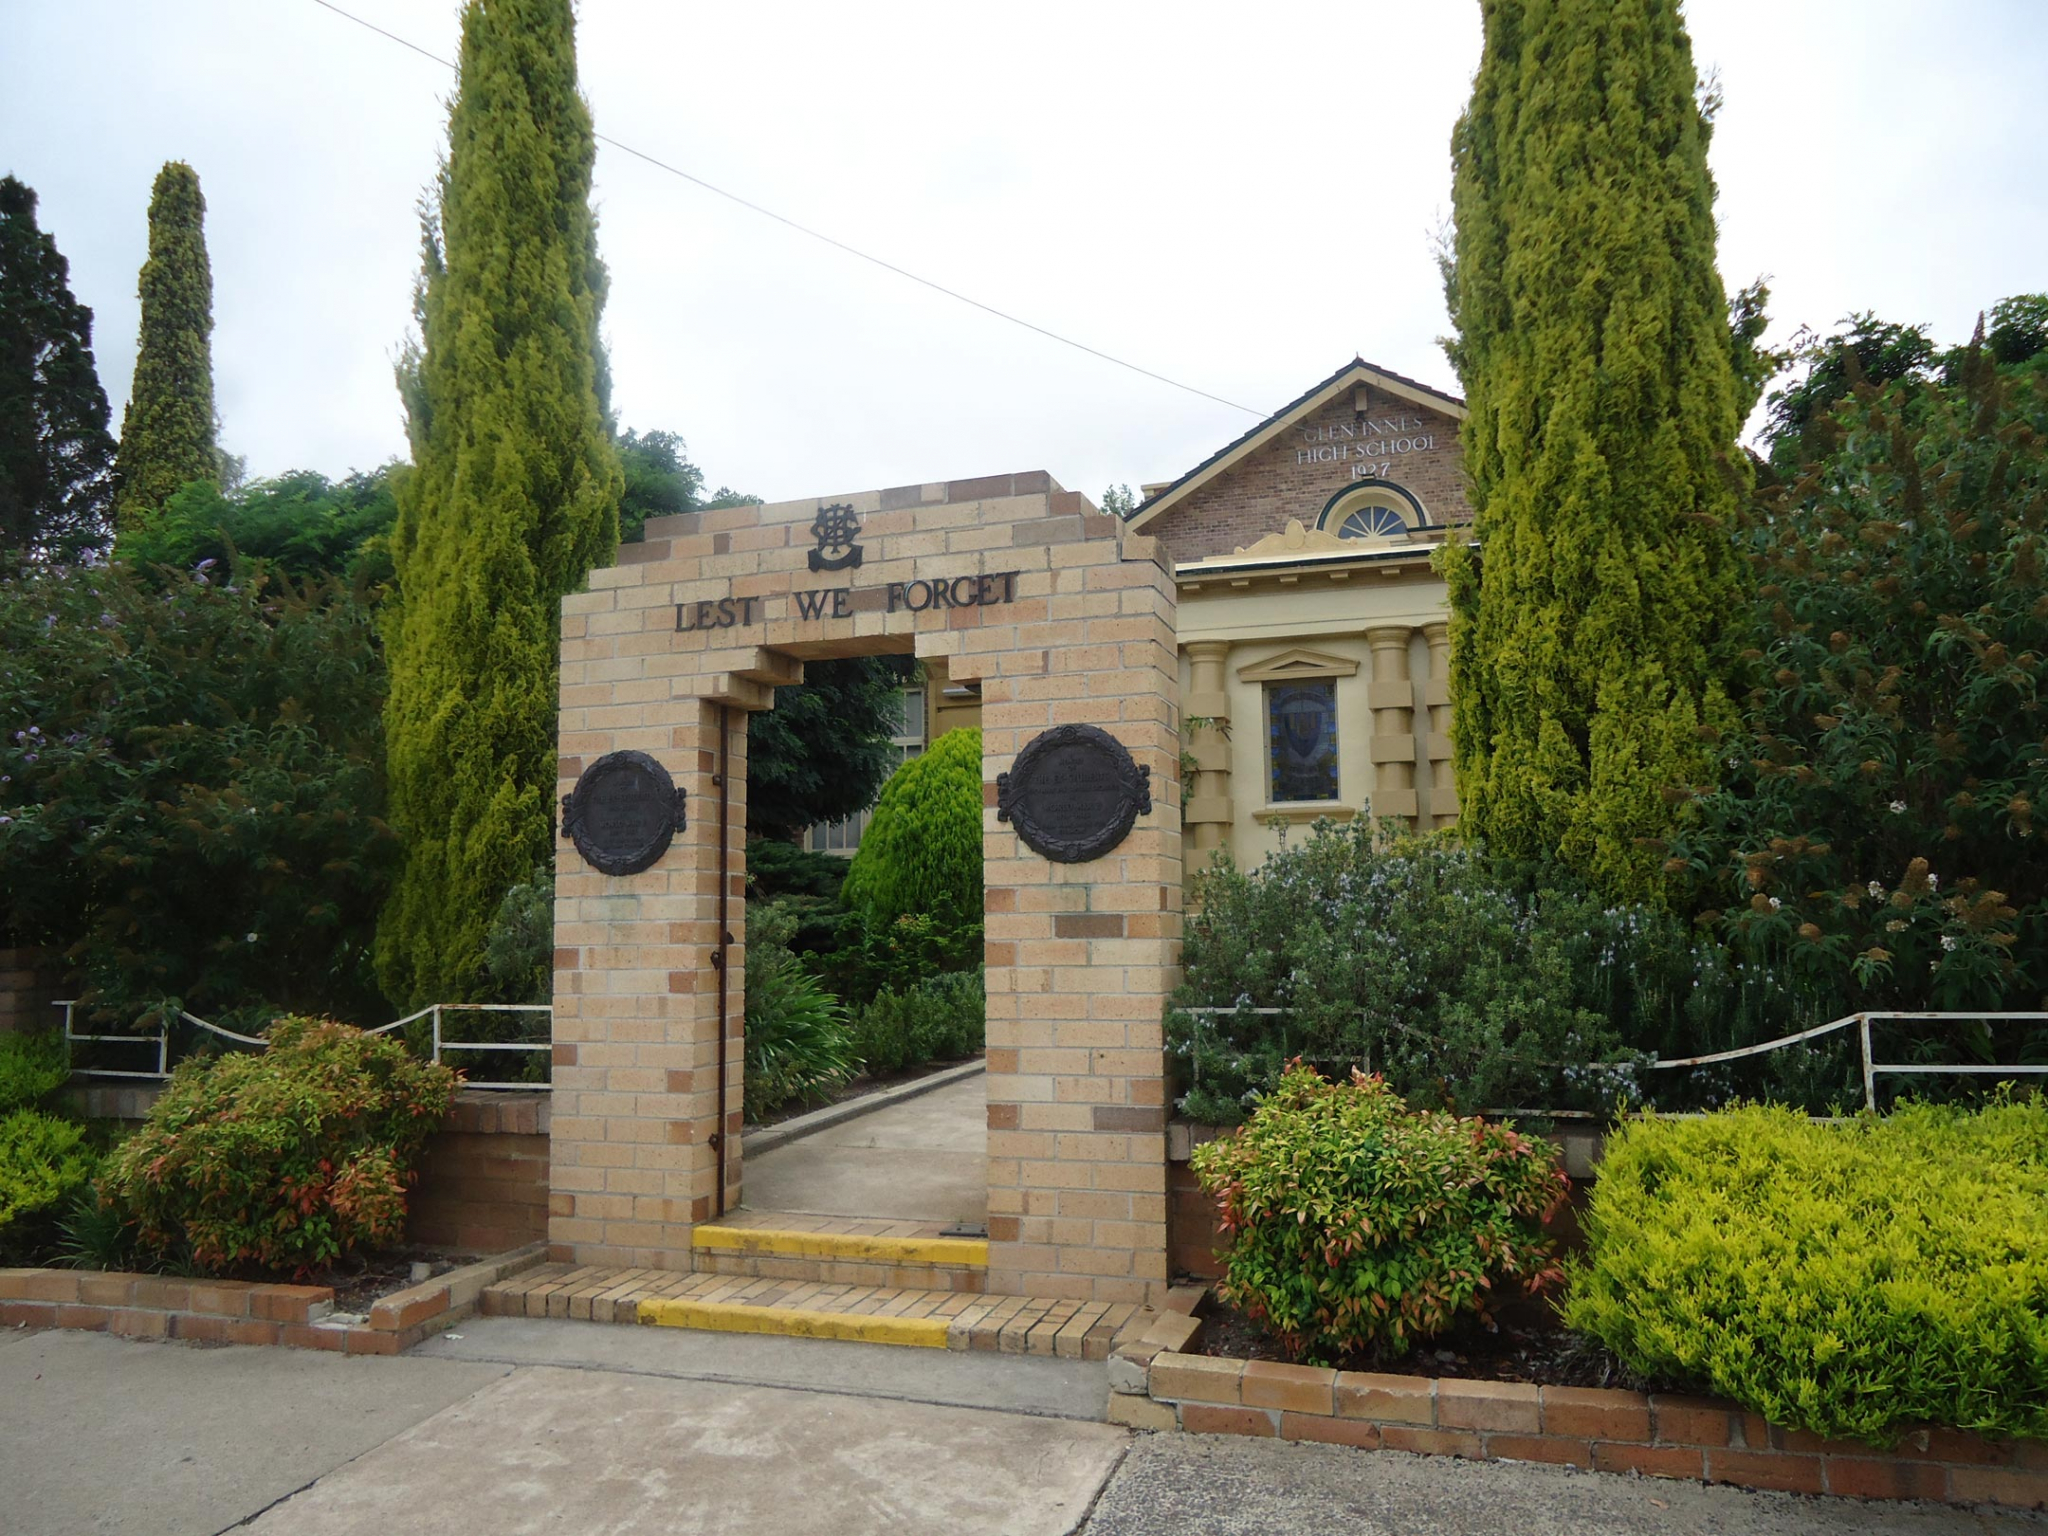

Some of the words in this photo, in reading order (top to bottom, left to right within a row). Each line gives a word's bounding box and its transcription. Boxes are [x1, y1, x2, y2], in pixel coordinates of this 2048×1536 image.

[1304, 423, 1355, 442] GLEN
[1363, 417, 1423, 436] INNES
[1297, 445, 1348, 465] HIGH
[1355, 435, 1439, 458] SCHOOL
[1351, 462, 1391, 480] 1927
[675, 595, 759, 633] LEST
[793, 588, 854, 622] WE
[886, 570, 1021, 614] FORGET
